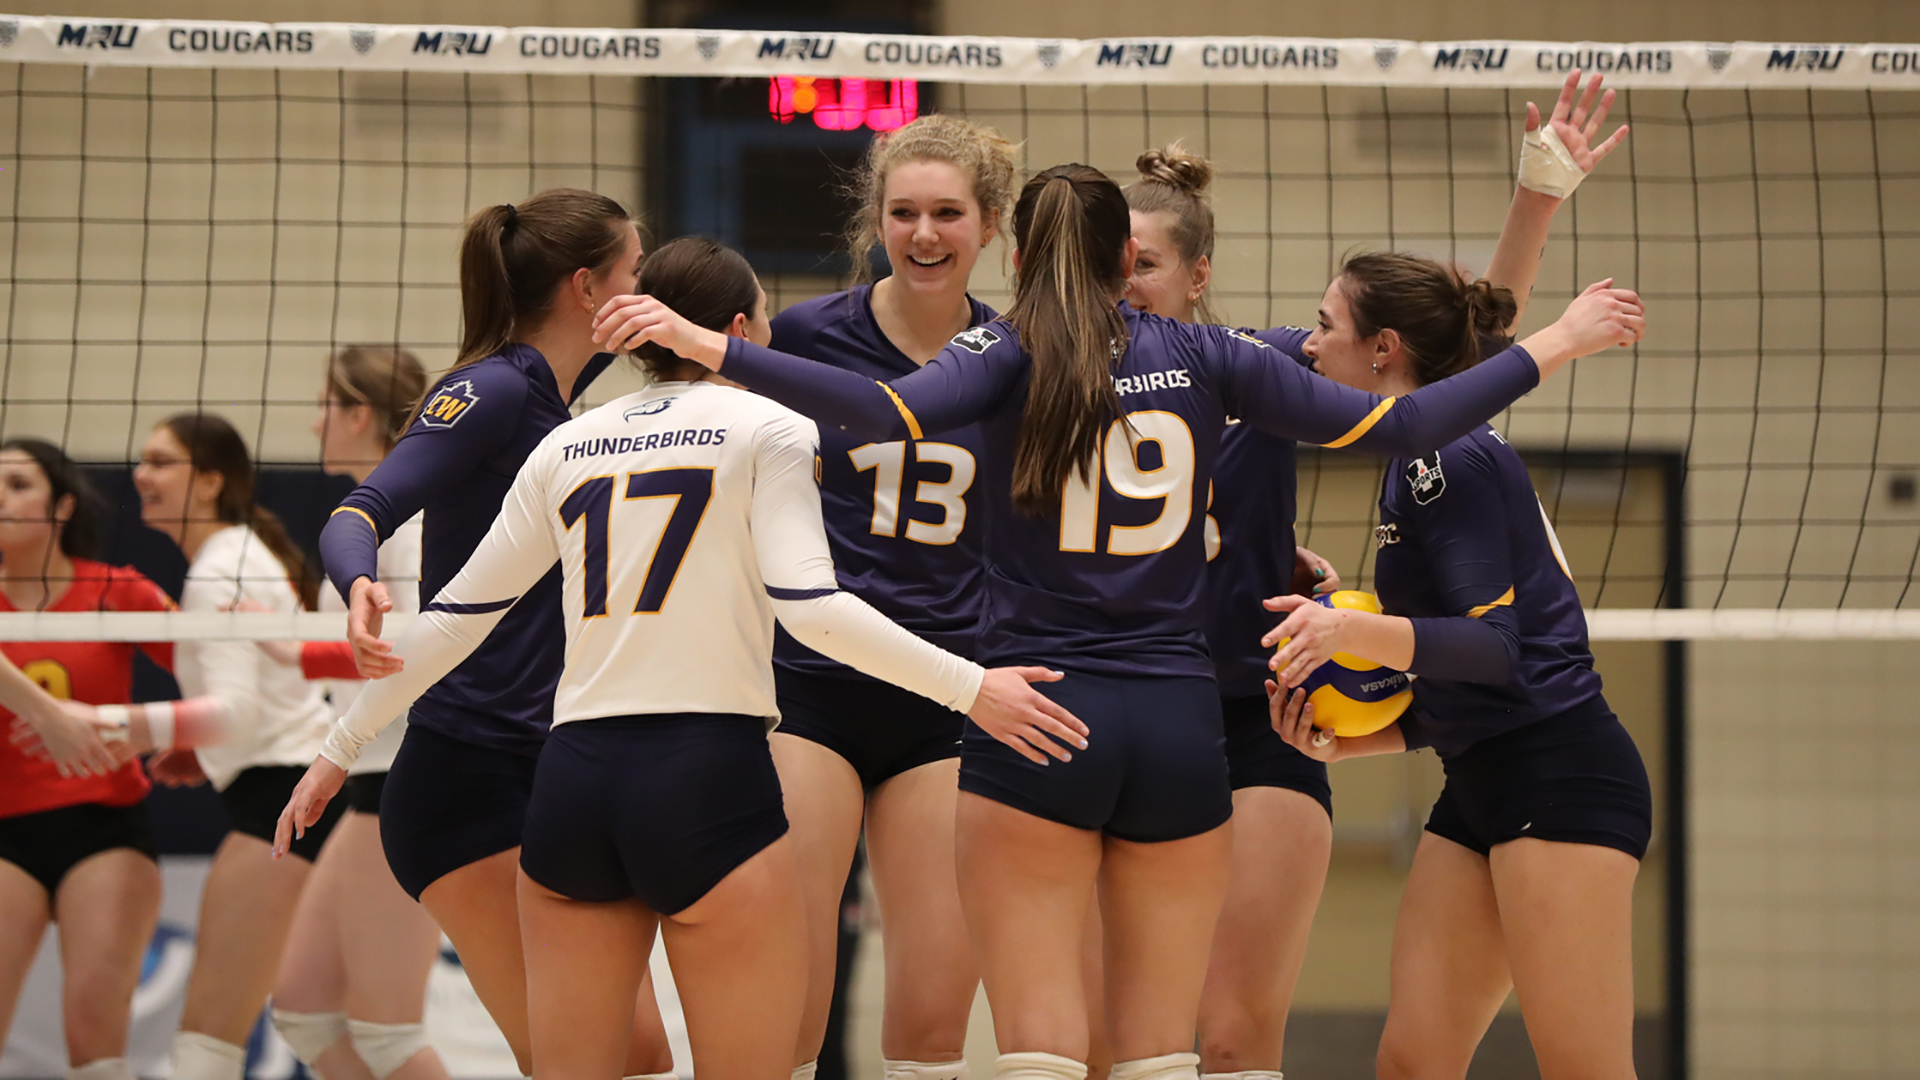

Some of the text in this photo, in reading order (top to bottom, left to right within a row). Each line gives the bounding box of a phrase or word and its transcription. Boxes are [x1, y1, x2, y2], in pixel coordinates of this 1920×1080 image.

[57, 23, 139, 50] MRU
[168, 28, 313, 54] COUGARS
[412, 30, 493, 57] MRU
[519, 35, 661, 60] COUGARS
[757, 37, 835, 62] MRU
[864, 42, 1003, 68] COUGARS
[1097, 43, 1174, 68] MRU
[1203, 44, 1338, 70] COUGARS
[1433, 47, 1509, 72] MRU
[1536, 50, 1672, 73] COUGARS
[1766, 49, 1845, 72] MRU
[563, 429, 727, 462] THUNDERBIRDS
[1059, 410, 1195, 556] 19
[1412, 467, 1441, 491] SPORTS
[847, 440, 977, 545] 13
[558, 465, 717, 621] 17
